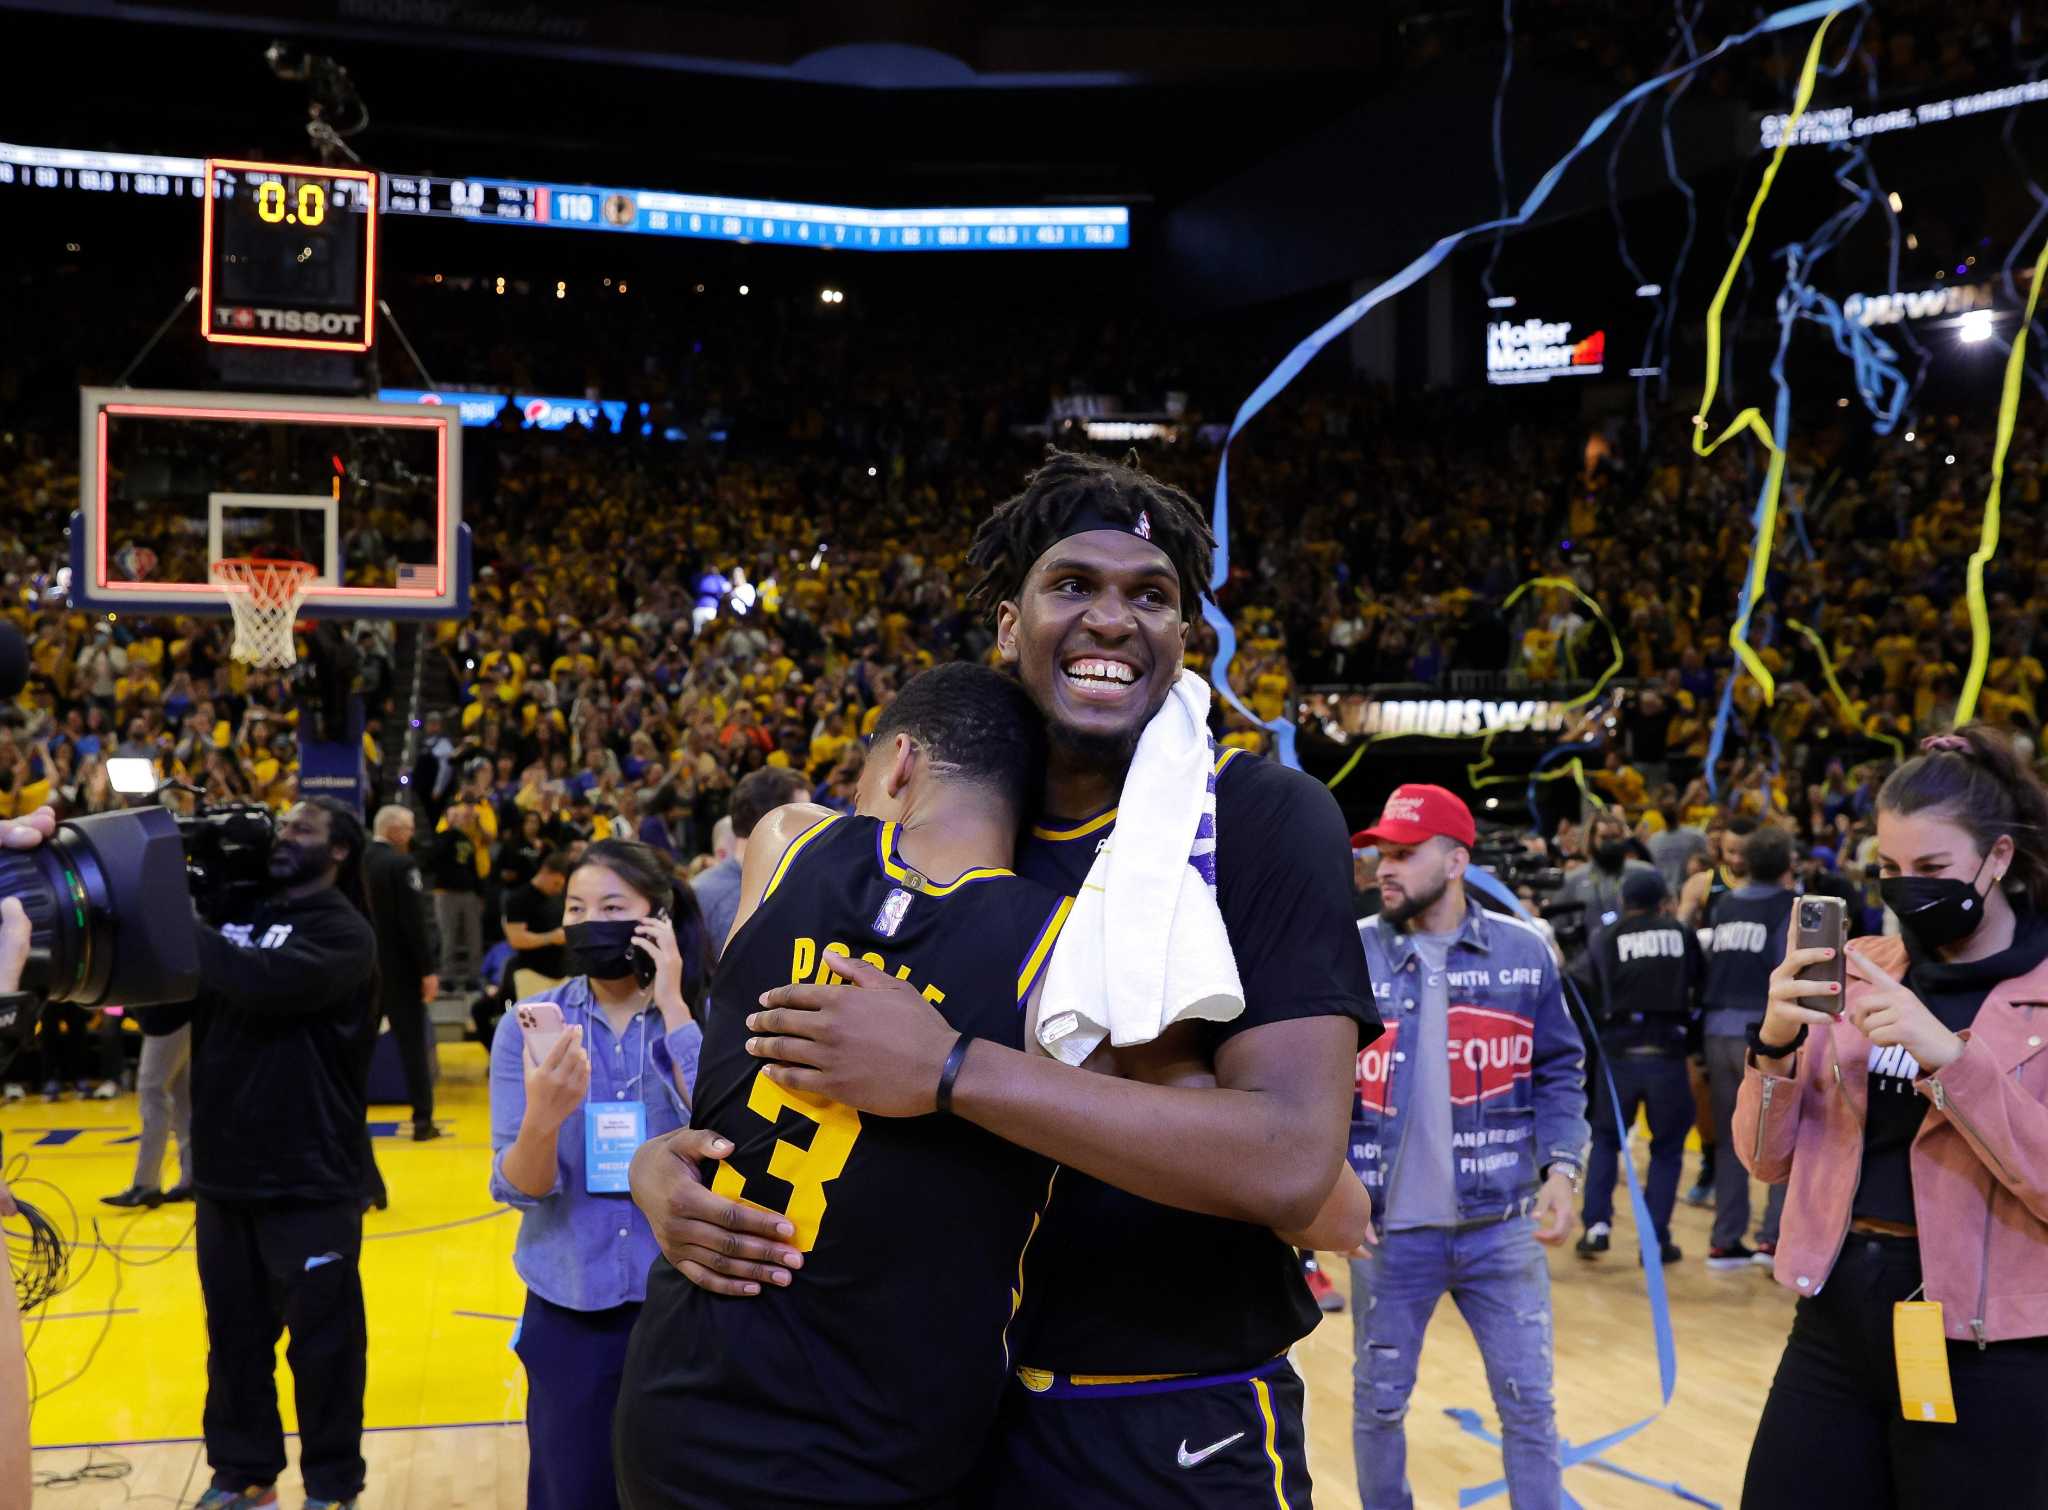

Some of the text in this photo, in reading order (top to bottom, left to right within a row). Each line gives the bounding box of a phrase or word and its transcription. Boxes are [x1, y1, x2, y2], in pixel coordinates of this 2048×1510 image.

[259, 180, 325, 226] 0.0
[558, 194, 593, 221] 110
[256, 308, 361, 334] TISSOT
[1617, 929, 1684, 962] PHOTO
[1713, 921, 1767, 953] PHOTO
[1447, 968, 1542, 986] WITH CARE
[712, 1071, 861, 1253] 3
